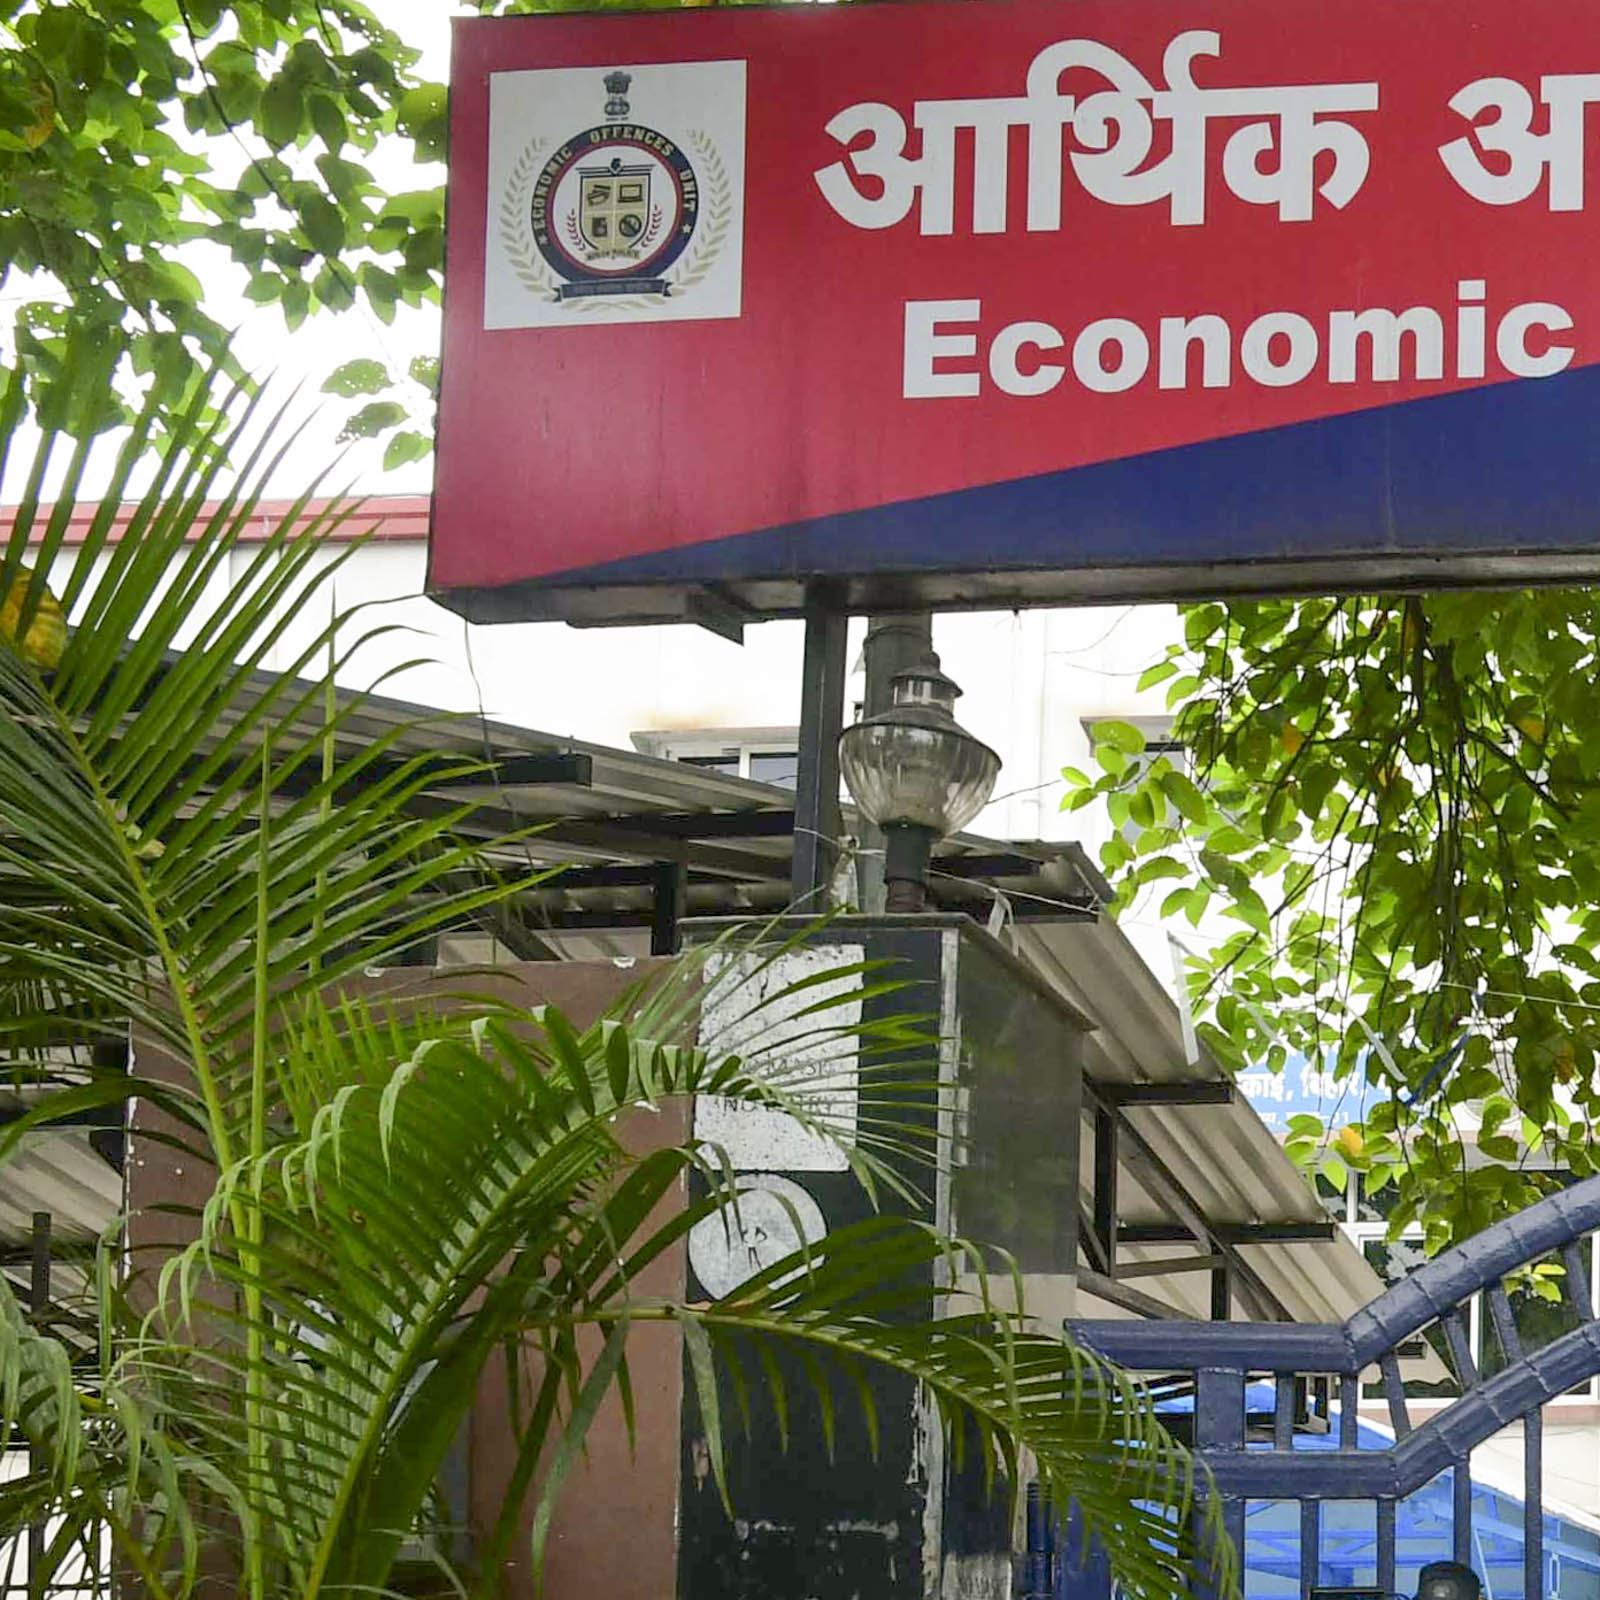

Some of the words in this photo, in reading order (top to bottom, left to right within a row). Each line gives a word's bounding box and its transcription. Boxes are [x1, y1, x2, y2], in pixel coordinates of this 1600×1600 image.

[533, 146, 573, 231] ECONOMIC
[590, 126, 675, 157] OFFENCES
[679, 169, 696, 212] UNIT
[815, 31, 1378, 235] आर्थिक
[904, 280, 1574, 402] Economic
